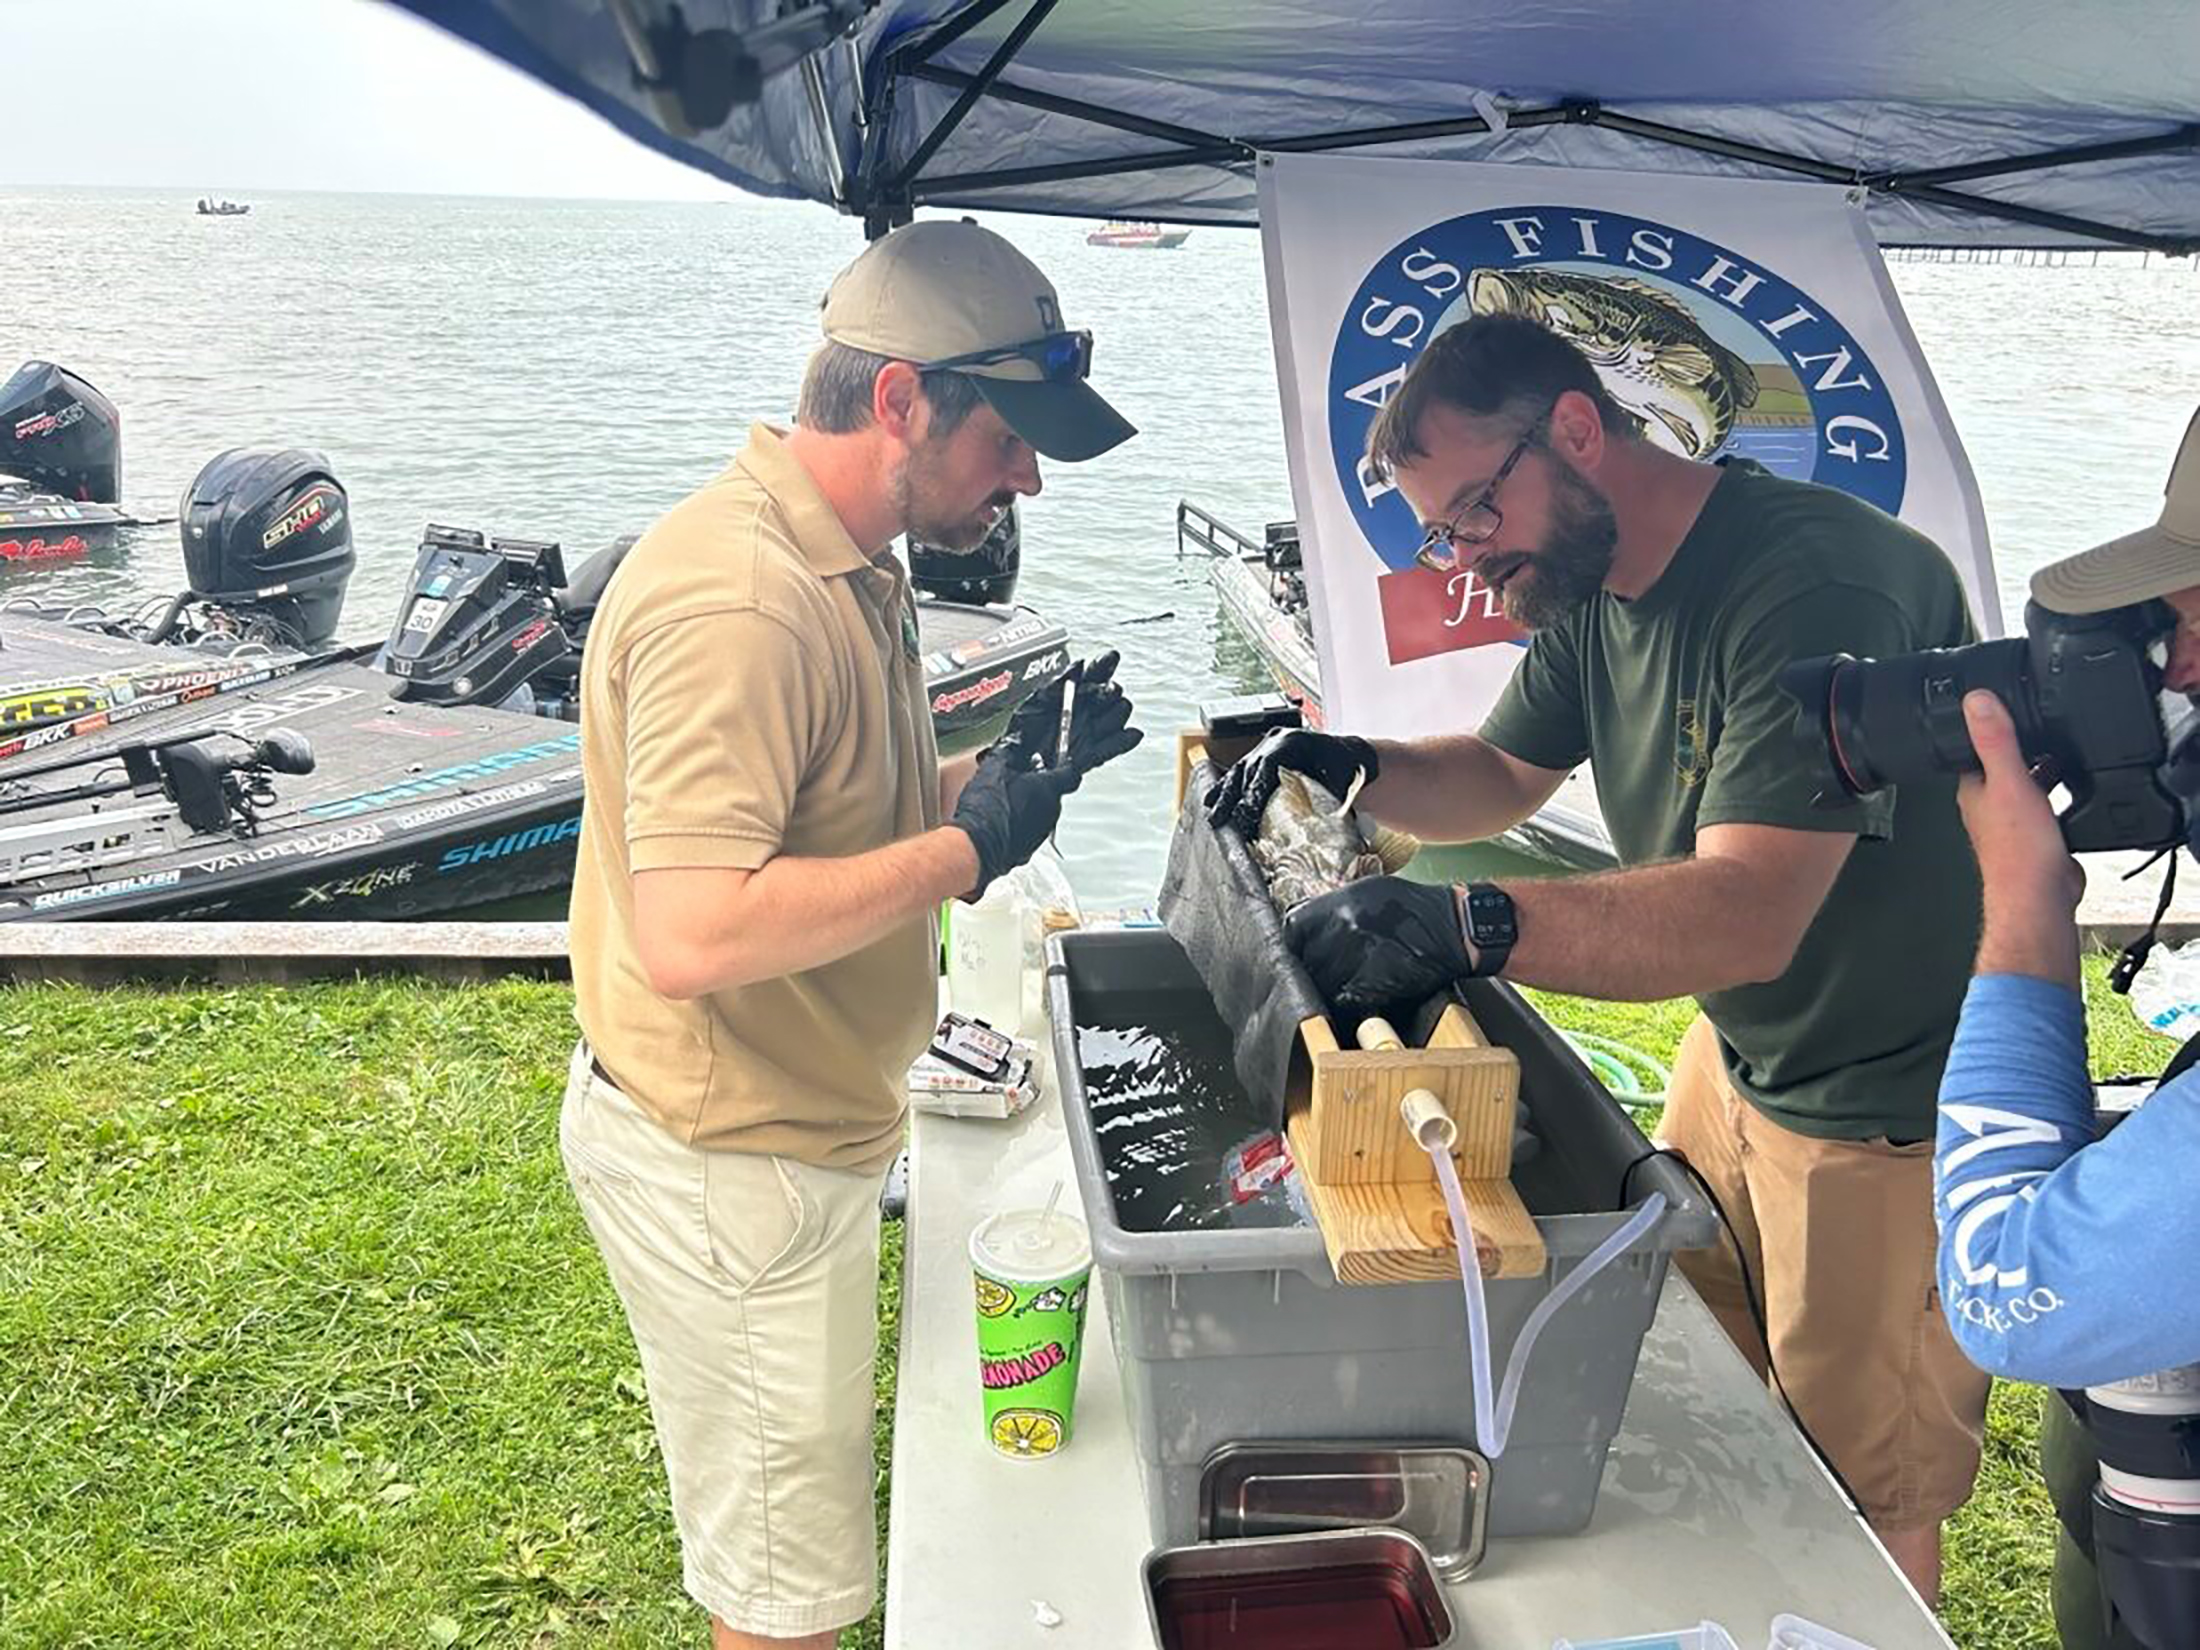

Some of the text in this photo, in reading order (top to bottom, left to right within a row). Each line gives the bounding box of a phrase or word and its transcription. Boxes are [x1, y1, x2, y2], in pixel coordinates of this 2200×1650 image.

[1493, 214, 1890, 465] FISHING
[409, 613, 434, 630] 30
[161, 663, 252, 691] PHOENIX
[23, 723, 67, 750] BKK
[199, 823, 384, 874] VANDERLAAN
[438, 815, 581, 872] SHIMA
[33, 869, 181, 912] QUICKSILVER
[2008, 1287, 2065, 1324] CO.
[981, 1342, 1066, 1389] MONADE
